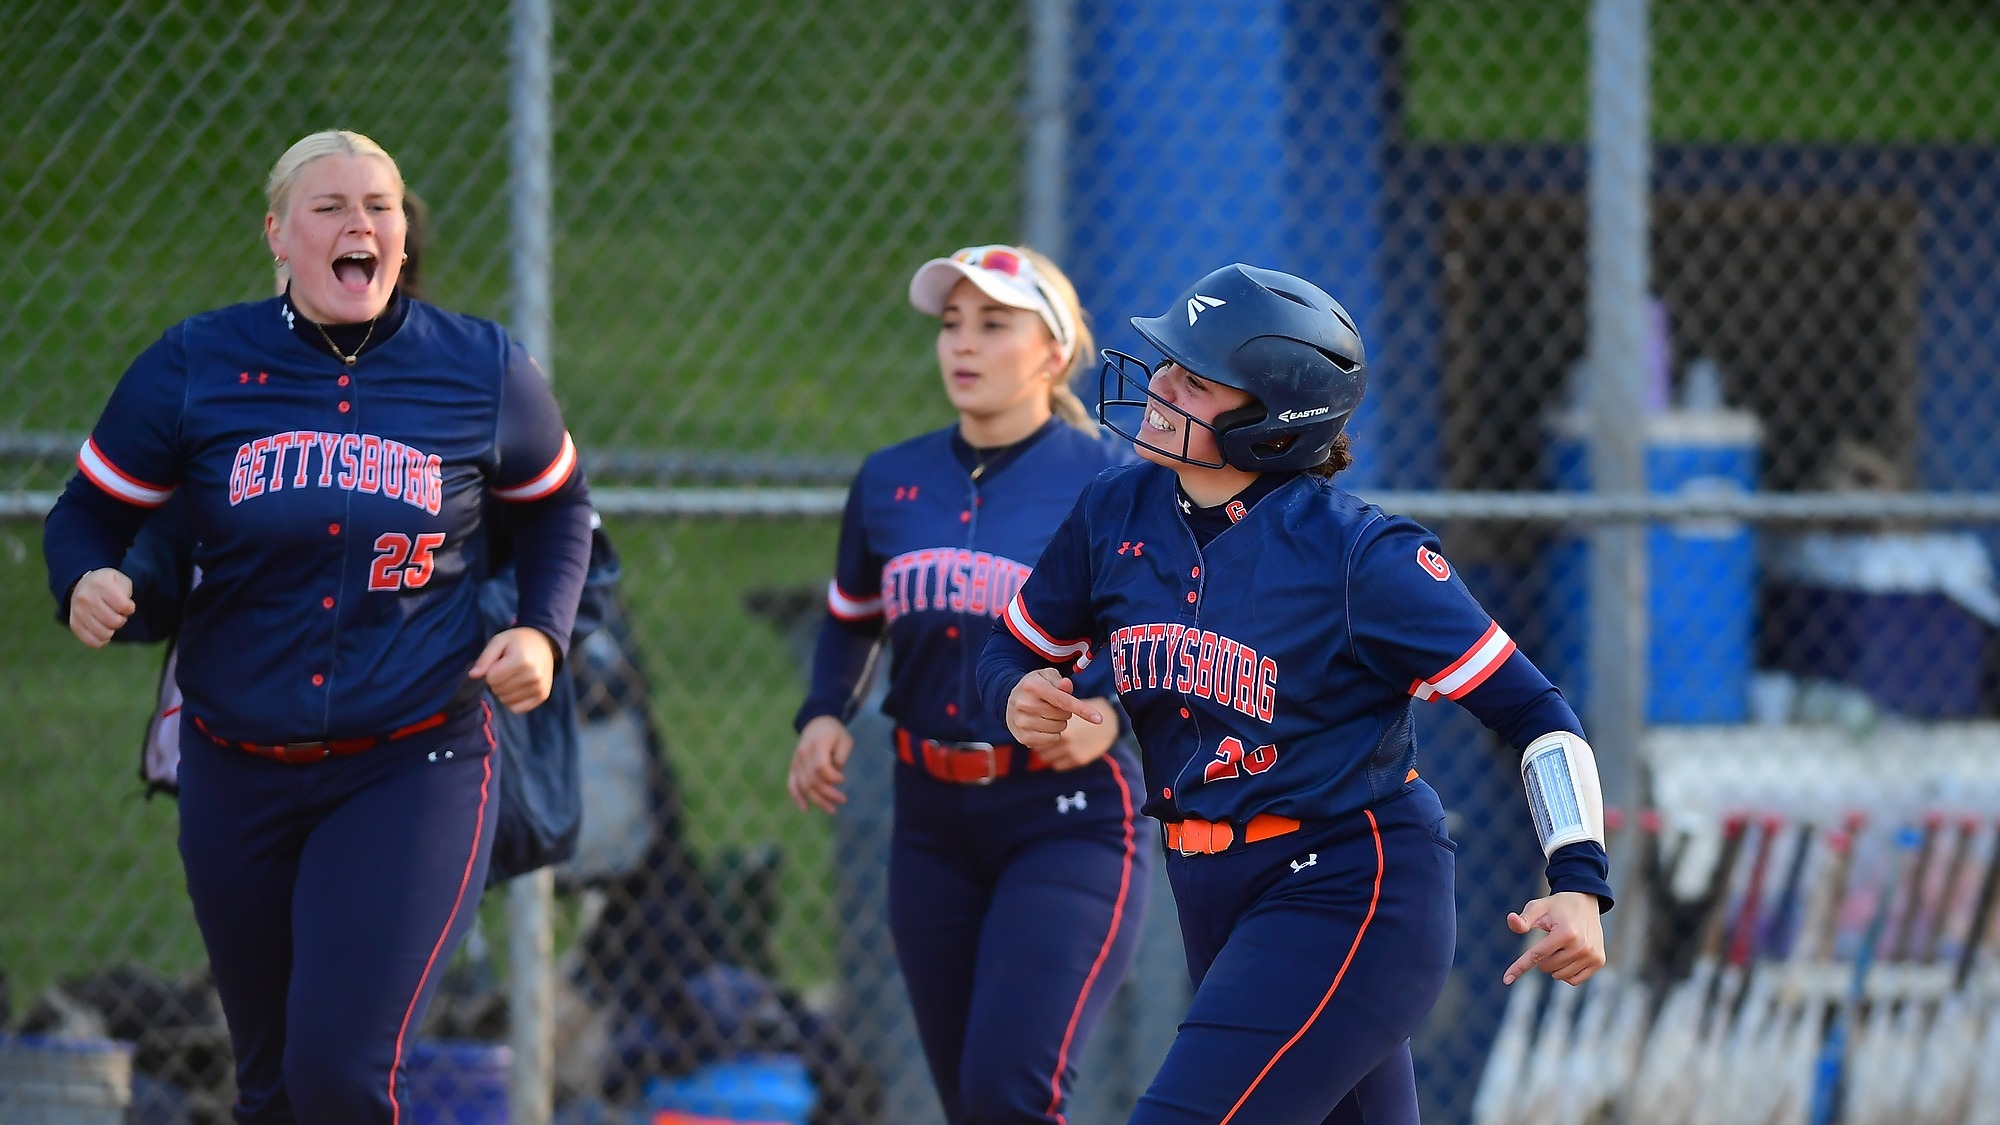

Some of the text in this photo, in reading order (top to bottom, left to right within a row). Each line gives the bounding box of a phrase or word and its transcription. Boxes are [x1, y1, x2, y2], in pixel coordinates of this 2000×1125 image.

[1290, 406, 1330, 420] EASTON
[229, 431, 443, 516] GETTYSBURG
[1225, 500, 1248, 524] G
[368, 532, 446, 591] 25
[1416, 545, 1451, 582] G
[1110, 623, 1278, 724] GETTYSBURG
